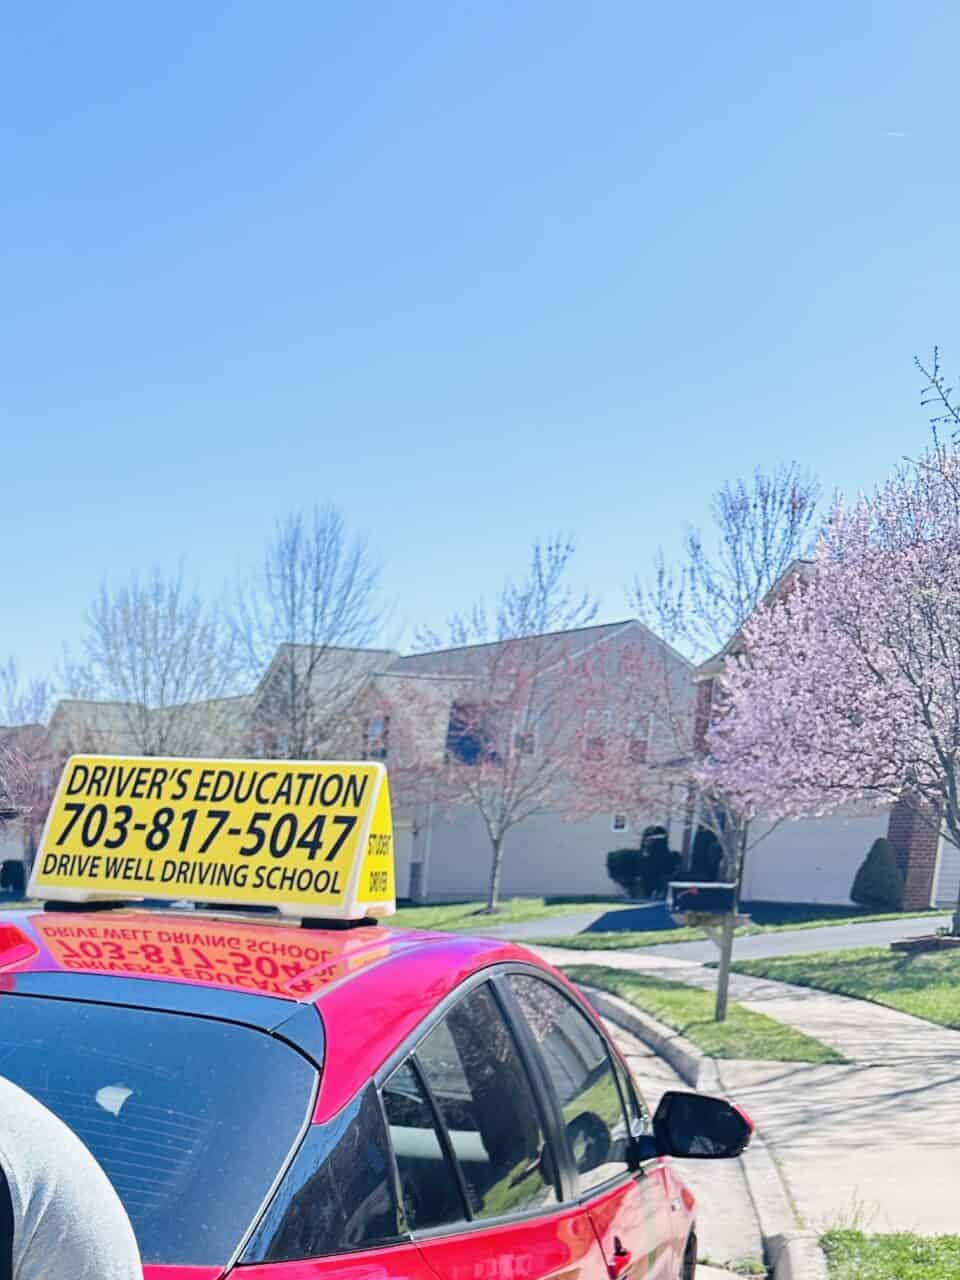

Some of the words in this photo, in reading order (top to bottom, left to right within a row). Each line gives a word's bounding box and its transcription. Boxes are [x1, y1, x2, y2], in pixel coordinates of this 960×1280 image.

[66, 765, 192, 801] DRIVER'S
[193, 769, 368, 807] EDUCATION
[56, 803, 357, 862] 703-817-5047
[42, 853, 102, 878] DRIVE
[105, 857, 155, 882] WELL
[160, 860, 249, 888] DRIVING
[252, 865, 341, 894] SCHOOL
